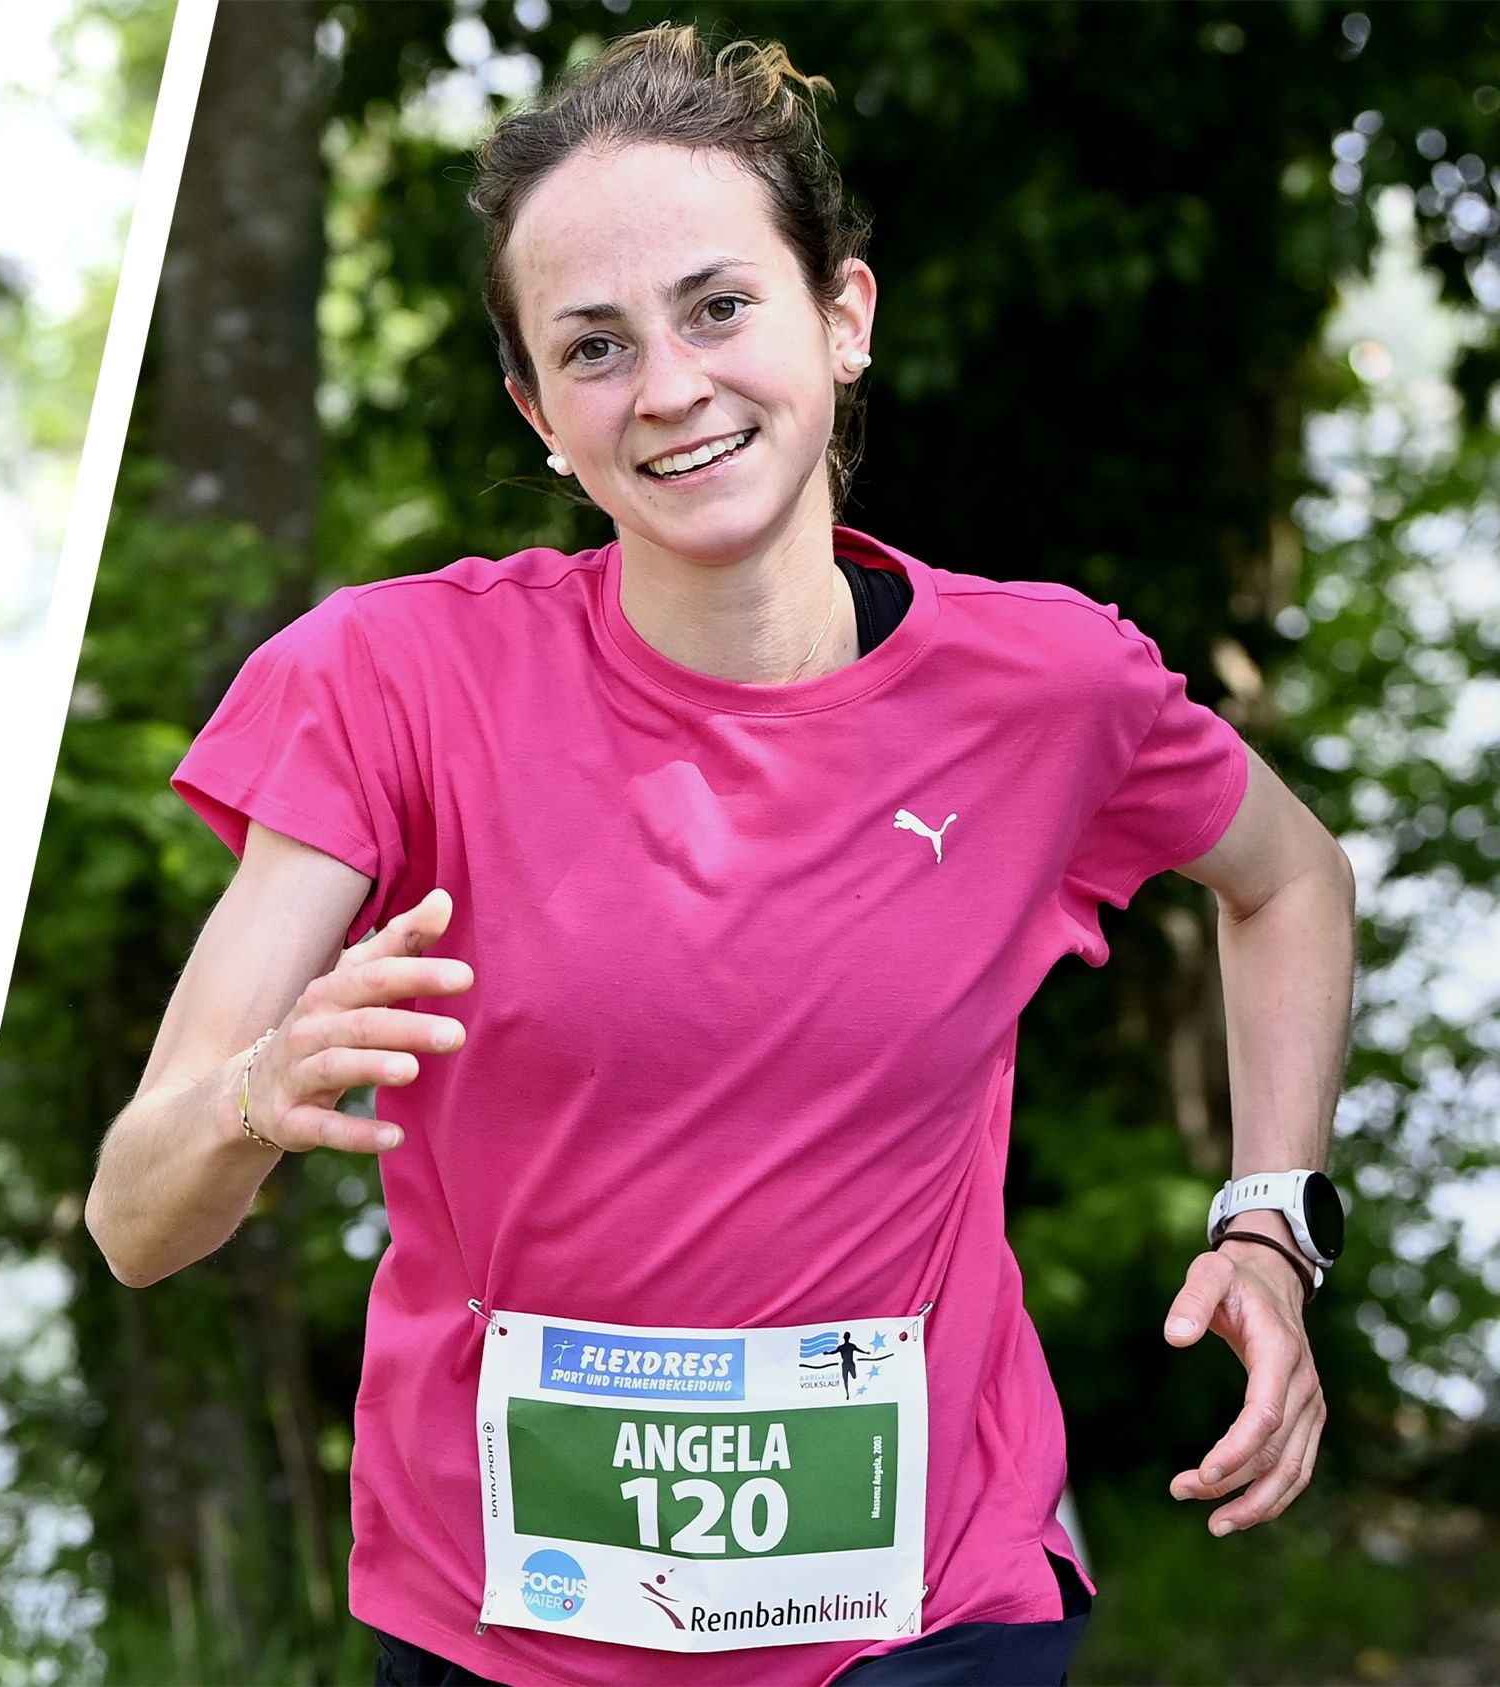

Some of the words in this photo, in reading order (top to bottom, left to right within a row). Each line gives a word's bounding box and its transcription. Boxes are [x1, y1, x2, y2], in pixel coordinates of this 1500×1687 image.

[580, 1345, 734, 1378] FLEXDRESS
[550, 1369, 585, 1385] SPORT
[586, 1374, 611, 1387] UND
[613, 1375, 733, 1393] FIRMENBEKLEIDUNG
[799, 1372, 840, 1381] AARGAUER
[799, 1380, 841, 1389] VOLKSLAUF
[612, 1422, 792, 1472] ANGELA
[873, 1435, 883, 1455] 2003
[487, 1435, 498, 1518] DATASPORT
[872, 1455, 884, 1485] Angela,
[619, 1476, 790, 1554] 120
[520, 1570, 588, 1598] FOCUS
[523, 1592, 561, 1609] WATER
[690, 1592, 888, 1633] Rennbahnklinik
